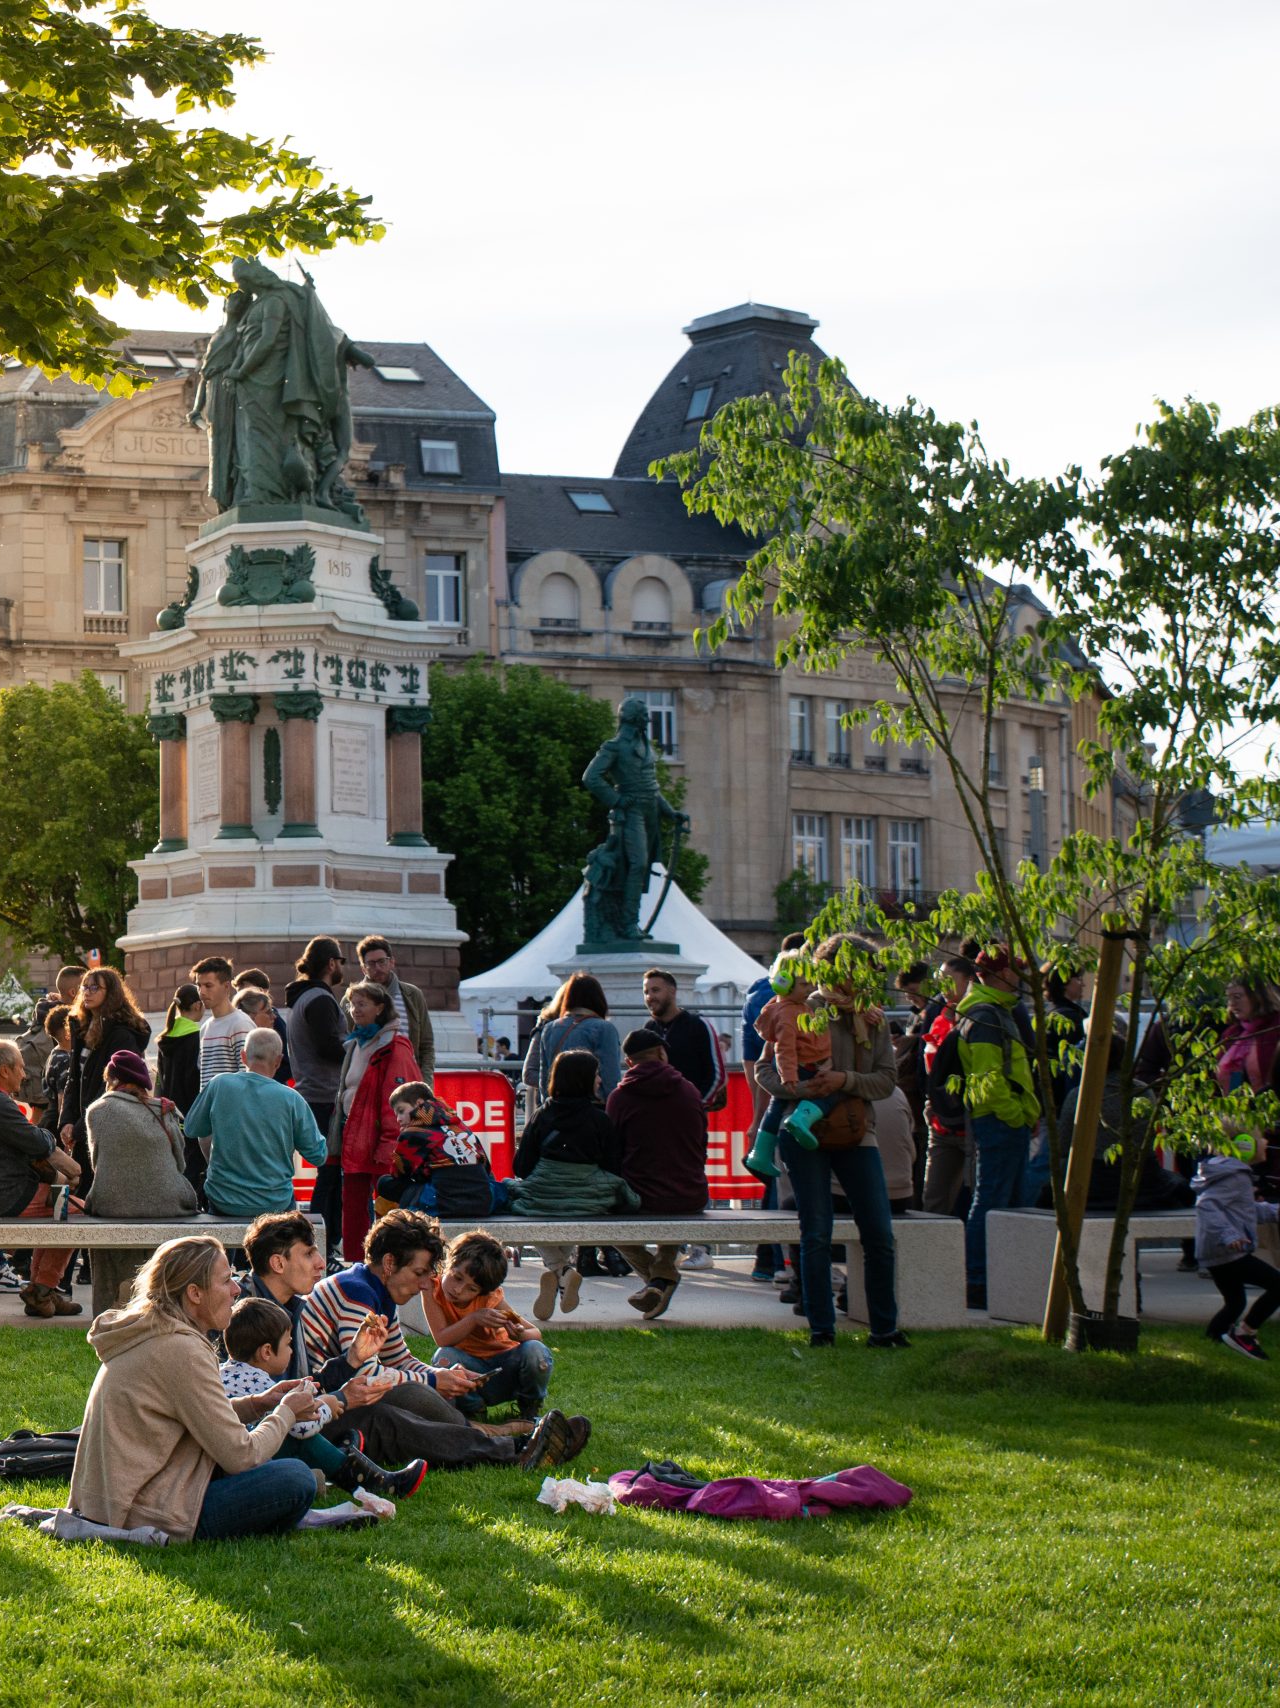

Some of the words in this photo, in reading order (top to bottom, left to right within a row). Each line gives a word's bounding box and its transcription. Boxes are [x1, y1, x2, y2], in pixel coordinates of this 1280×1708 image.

[124, 435, 209, 457] JUSTICE
[328, 559, 352, 578] 1815
[456, 1100, 505, 1127] DE
